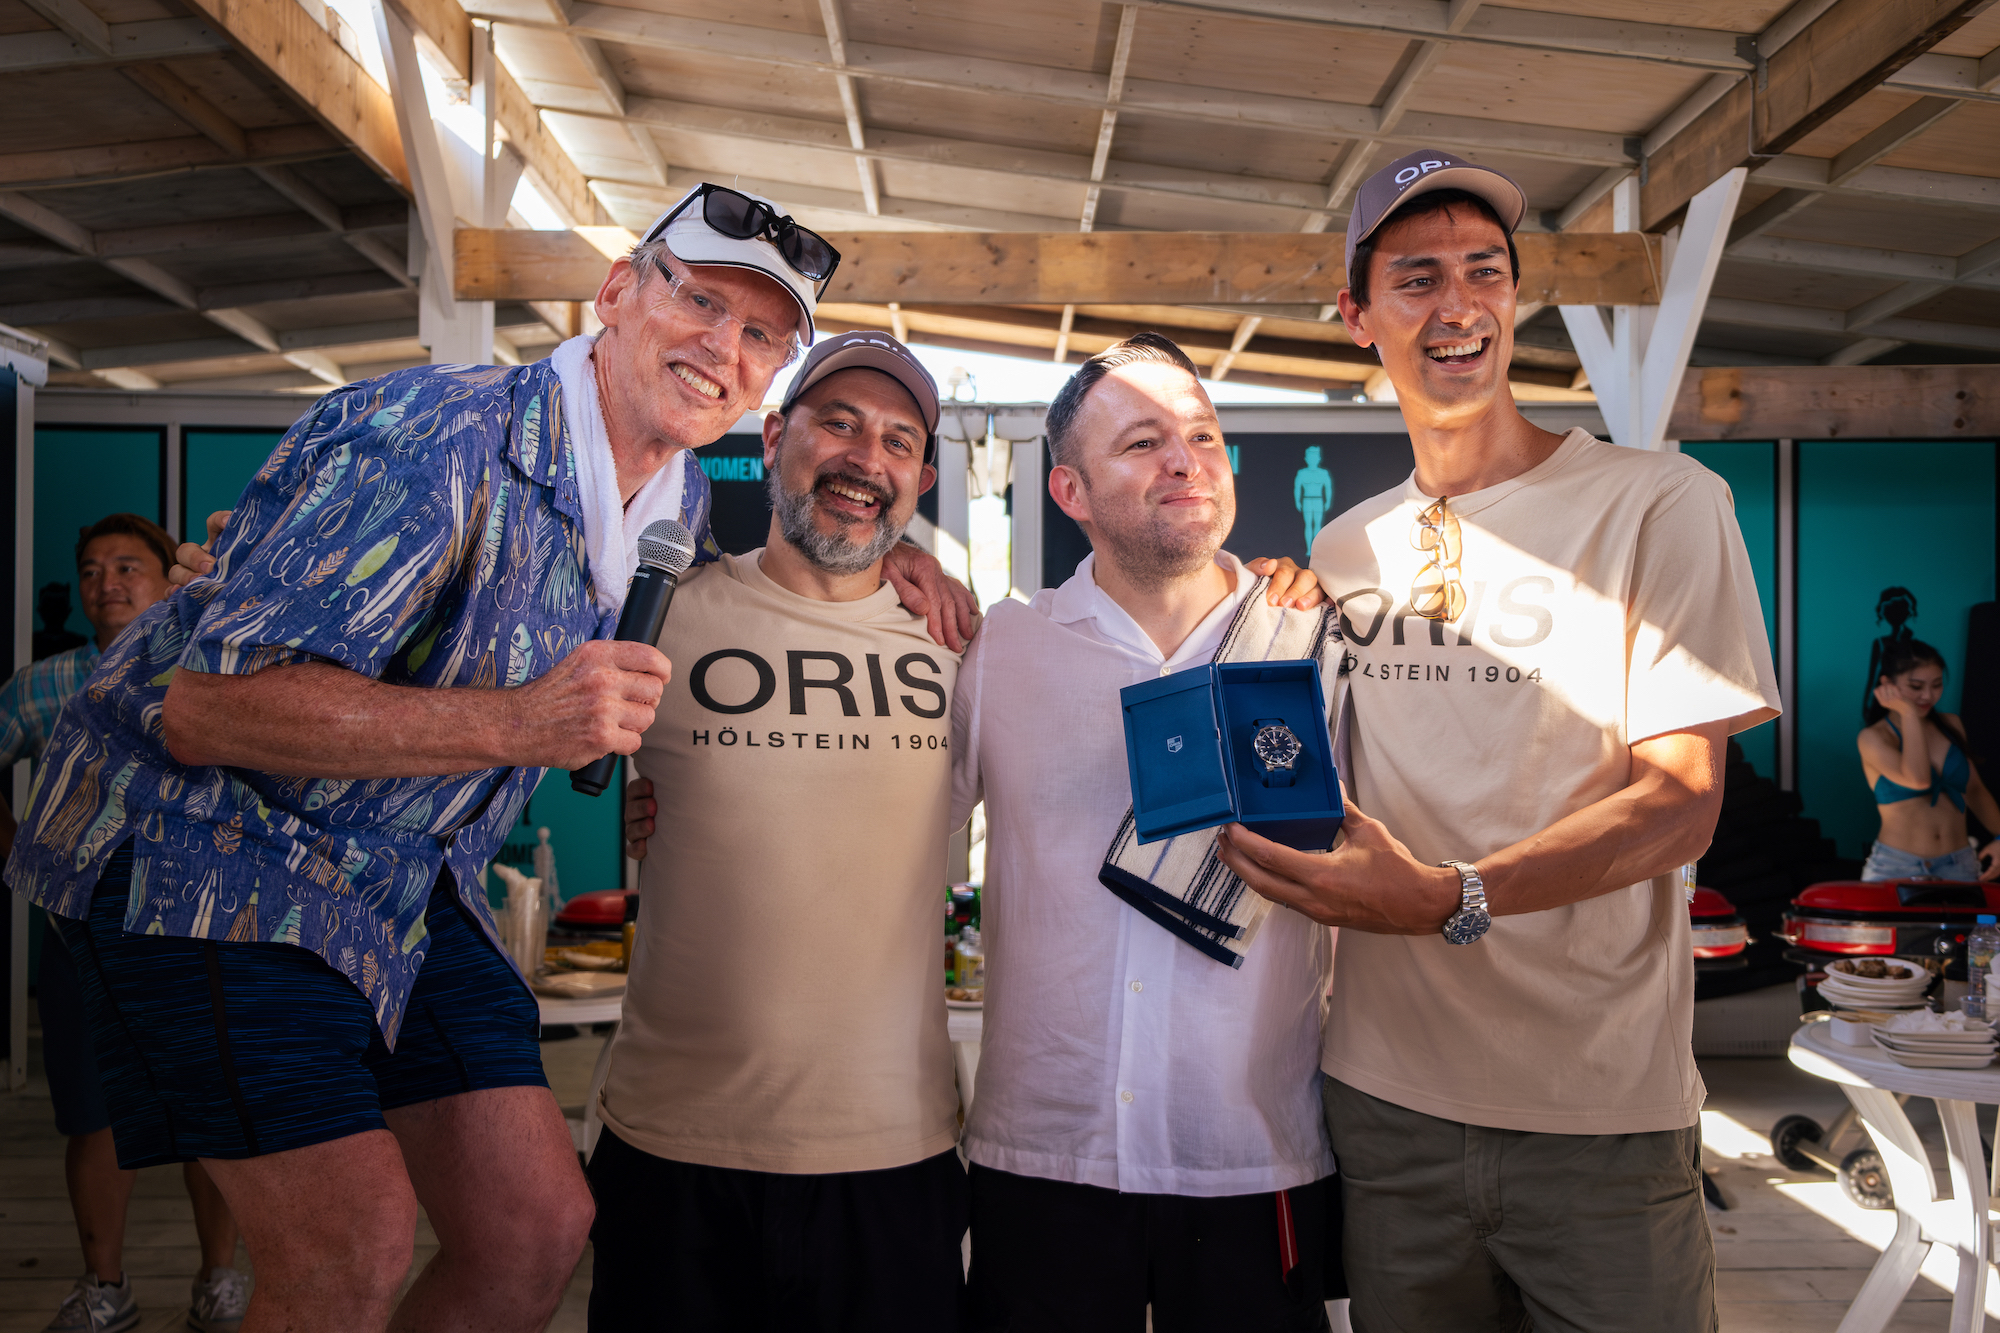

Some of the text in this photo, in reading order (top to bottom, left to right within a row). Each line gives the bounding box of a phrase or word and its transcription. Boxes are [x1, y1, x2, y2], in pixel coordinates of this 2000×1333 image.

[1395, 160, 1451, 184] OR
[1336, 575, 1555, 648] ORIS
[1347, 652, 1543, 683] ÖLSTEIN 1904
[689, 648, 947, 719] ORIS
[692, 727, 948, 750] HÖLSTEIN 1904
